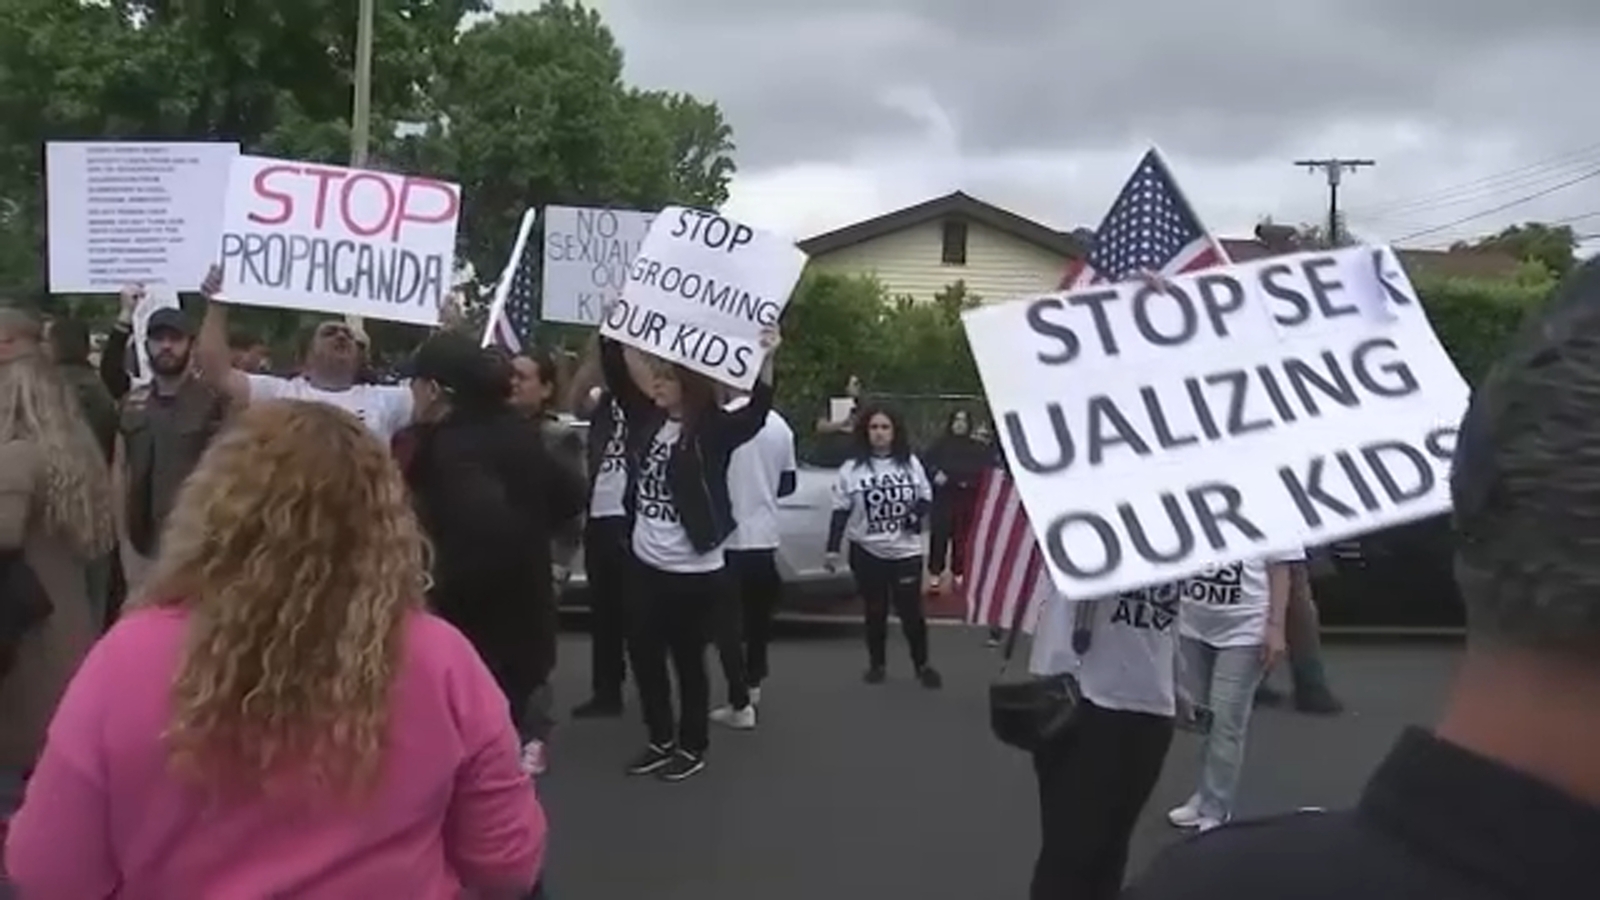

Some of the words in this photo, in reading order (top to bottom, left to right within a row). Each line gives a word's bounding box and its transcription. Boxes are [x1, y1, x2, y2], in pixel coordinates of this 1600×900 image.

[247, 165, 458, 242] STOP
[578, 209, 618, 239] NO
[671, 209, 753, 252] STOP
[219, 233, 444, 310] PROPAGANDA
[592, 261, 629, 291] OU
[631, 257, 780, 327] GROOMING
[607, 299, 667, 347] OUR
[670, 324, 754, 379] KIDS
[1026, 273, 1245, 366] STOP
[1005, 338, 1420, 476] UALIZING
[870, 502, 906, 519] KID
[1045, 481, 1266, 581] OUR
